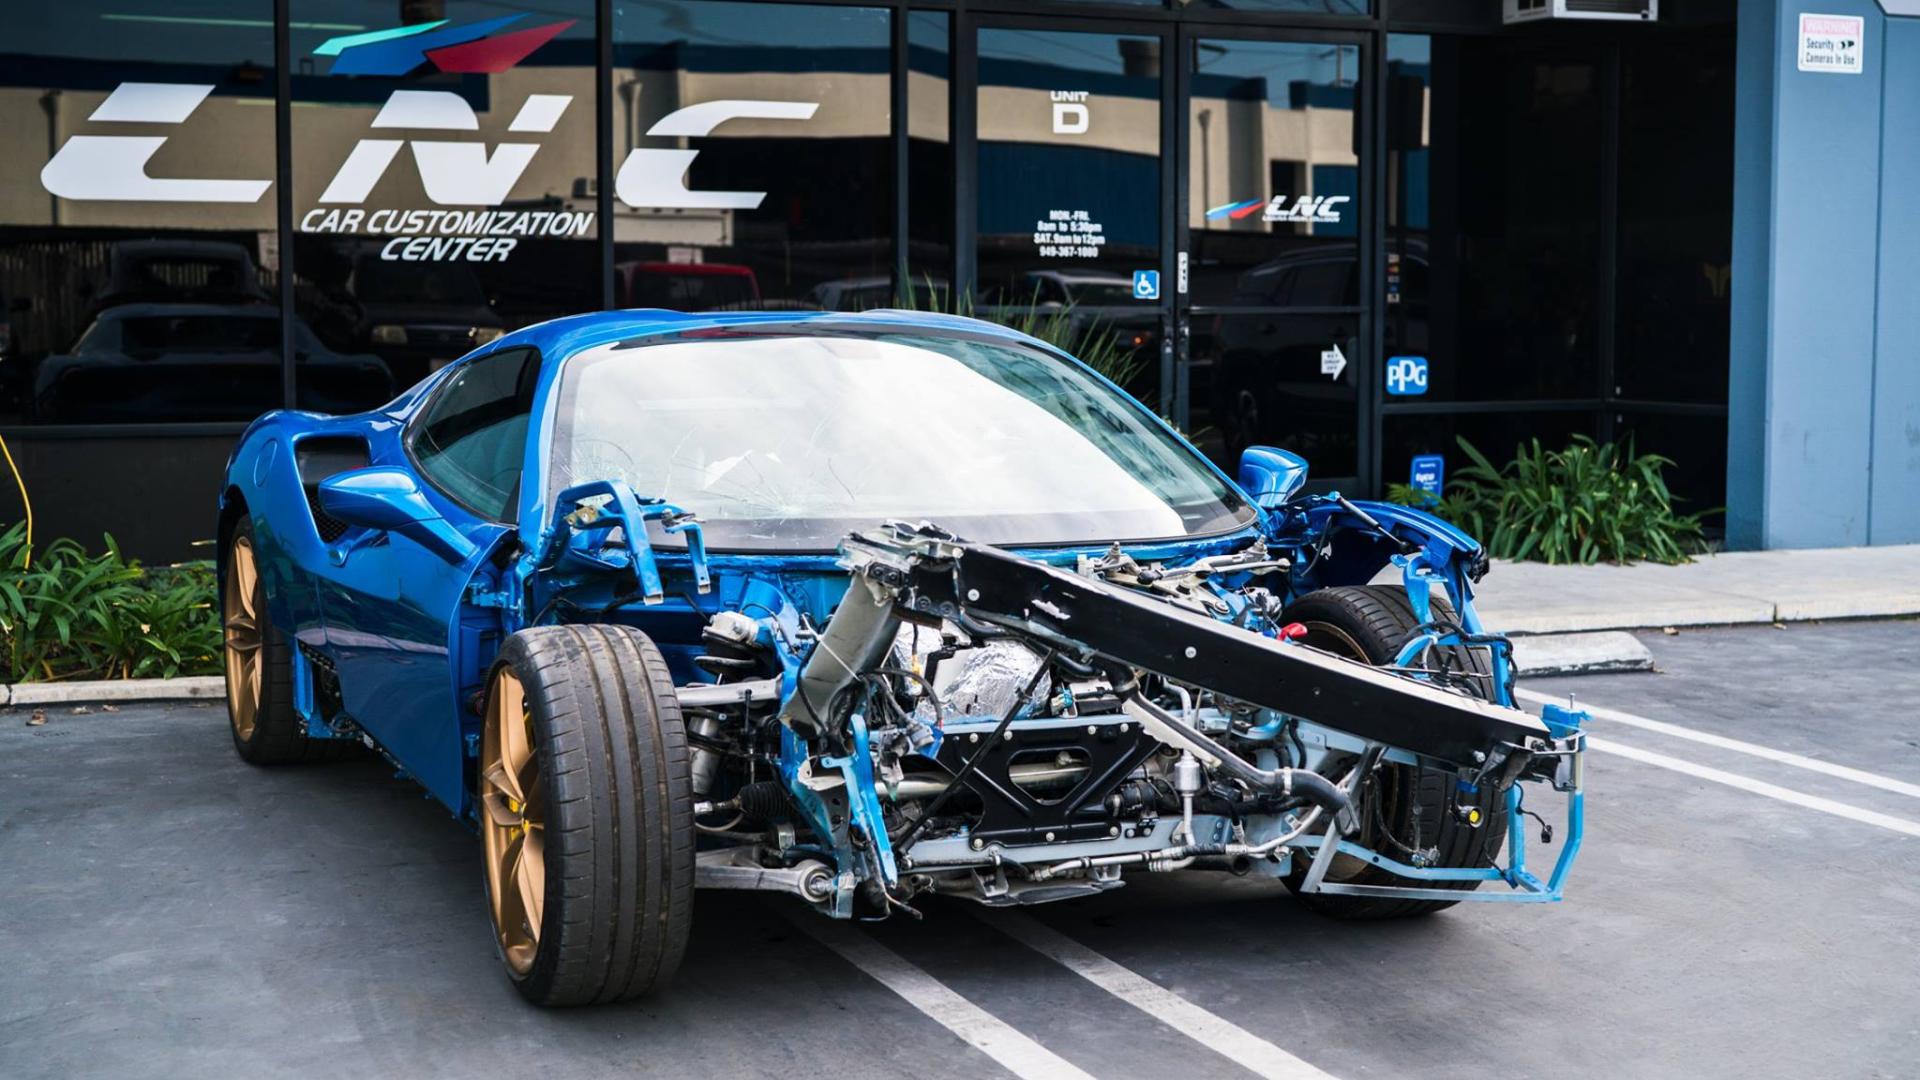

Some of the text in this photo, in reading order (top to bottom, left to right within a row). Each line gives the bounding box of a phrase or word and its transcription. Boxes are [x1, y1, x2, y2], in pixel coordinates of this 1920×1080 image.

[1806, 37, 1834, 51] Security
[1806, 52, 1834, 64] Cameras
[1843, 53, 1855, 65] Use
[1050, 90, 1089, 102] UNIT
[1053, 103, 1089, 134] D
[1265, 195, 1350, 217] LNC
[300, 209, 594, 236] CAR CUSTOMIZATION
[1058, 221, 1068, 232] to
[380, 237, 518, 262] CENTER
[1387, 360, 1427, 392] PPG
